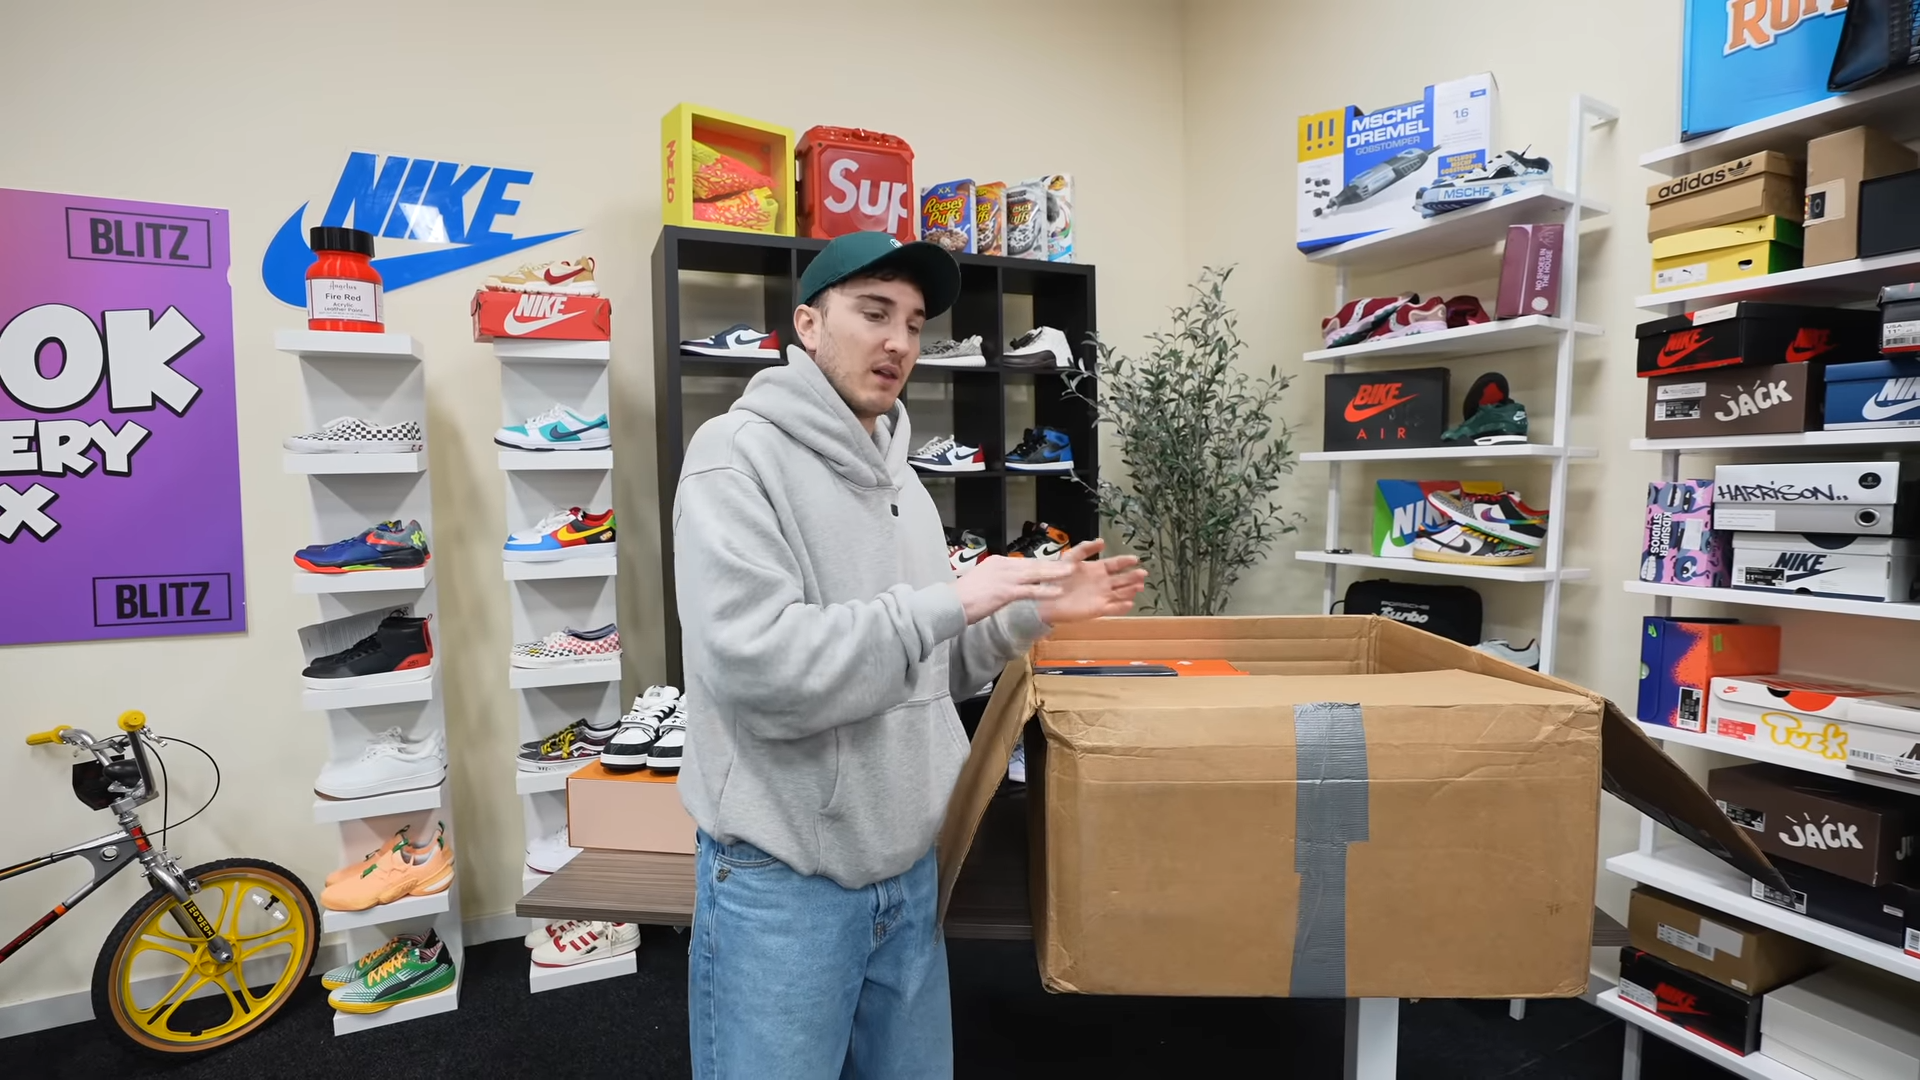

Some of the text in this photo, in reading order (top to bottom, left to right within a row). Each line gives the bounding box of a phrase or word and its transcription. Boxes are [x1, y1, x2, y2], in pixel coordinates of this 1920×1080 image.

[1351, 103, 1425, 133] MSCHF
[1346, 119, 1431, 149] DREMEL
[1355, 135, 1421, 156] GOBSTOMPER
[320, 151, 534, 244] NIKE
[1443, 186, 1490, 199] MSCHF
[1658, 166, 1726, 199] adidas
[924, 198, 964, 215] Reese's
[928, 210, 962, 227] Puffs
[89, 217, 190, 261] BLITZ
[1535, 248, 1547, 291] NO SHOES IN
[1542, 249, 1553, 288] THE HOUSE
[325, 293, 362, 302] Fire Red
[514, 293, 568, 318] NIKE
[1665, 328, 1703, 352] NIKE
[1353, 382, 1403, 405] BIKE
[1714, 379, 1793, 422] JACK
[1650, 512, 1663, 555] STUDIOS
[1658, 511, 1673, 557] KIDSUPER
[1774, 551, 1828, 573] NIKE
[115, 581, 211, 620] BLITZ
[1778, 820, 1864, 850] JACK
